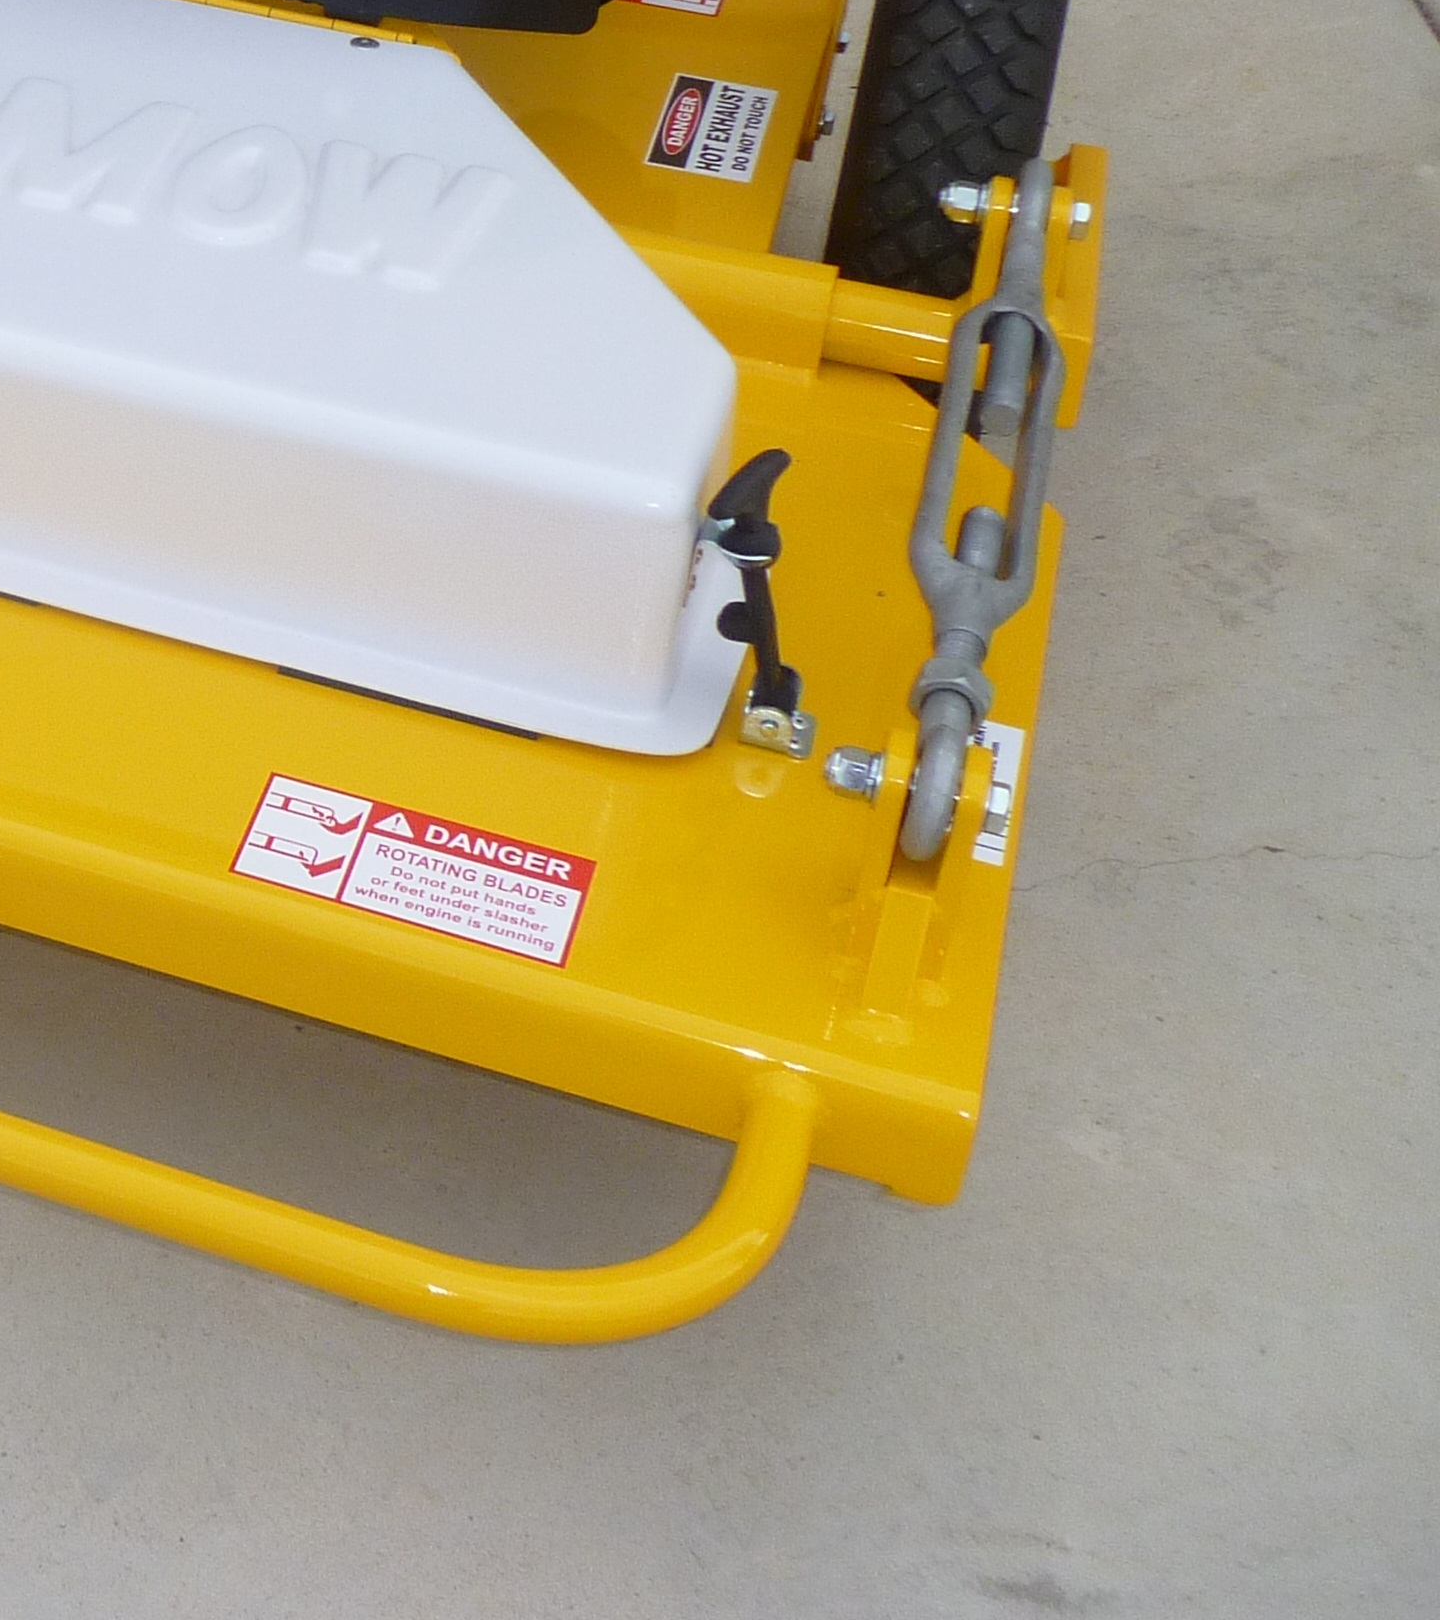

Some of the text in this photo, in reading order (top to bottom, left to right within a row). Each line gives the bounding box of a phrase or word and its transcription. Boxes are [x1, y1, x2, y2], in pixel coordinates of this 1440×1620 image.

[667, 96, 698, 147] DANGER
[695, 85, 746, 172] HOT EXHAUST
[731, 96, 769, 171] DO NOT TOUCH
[375, 843, 568, 908] ROTATING BLADES
[424, 824, 571, 881] DANGER
[354, 885, 556, 952] when engine is running
[370, 876, 549, 932] or feet under slasher
[390, 866, 536, 916] Do not put hands
